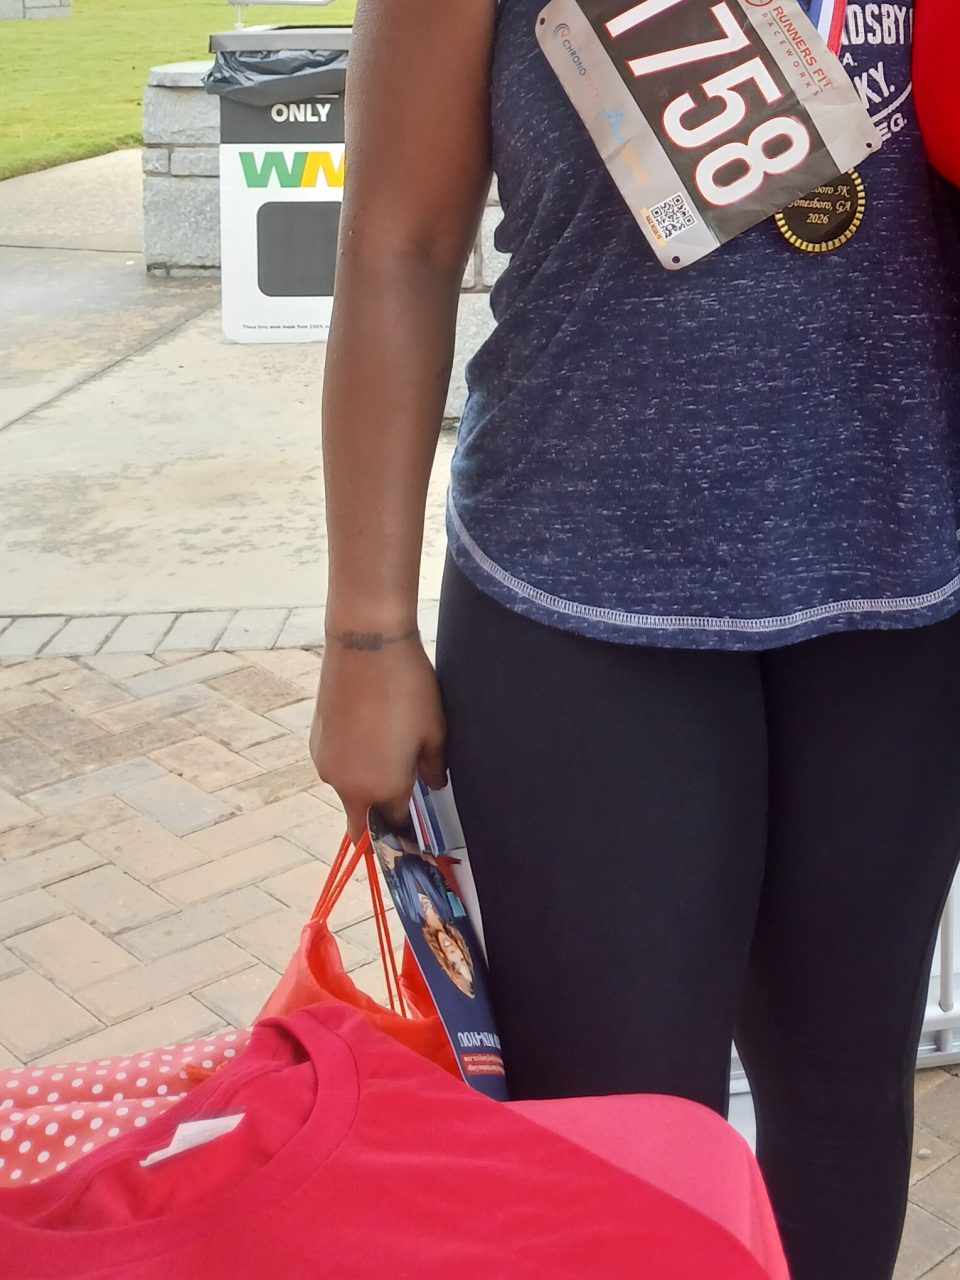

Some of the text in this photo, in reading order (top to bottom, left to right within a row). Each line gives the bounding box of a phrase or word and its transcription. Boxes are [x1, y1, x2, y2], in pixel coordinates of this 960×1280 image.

[773, 6, 833, 88] RUNNERS FIT
[271, 102, 331, 123] ONLY
[836, 200, 852, 214] GA
[806, 213, 829, 224] 2026
